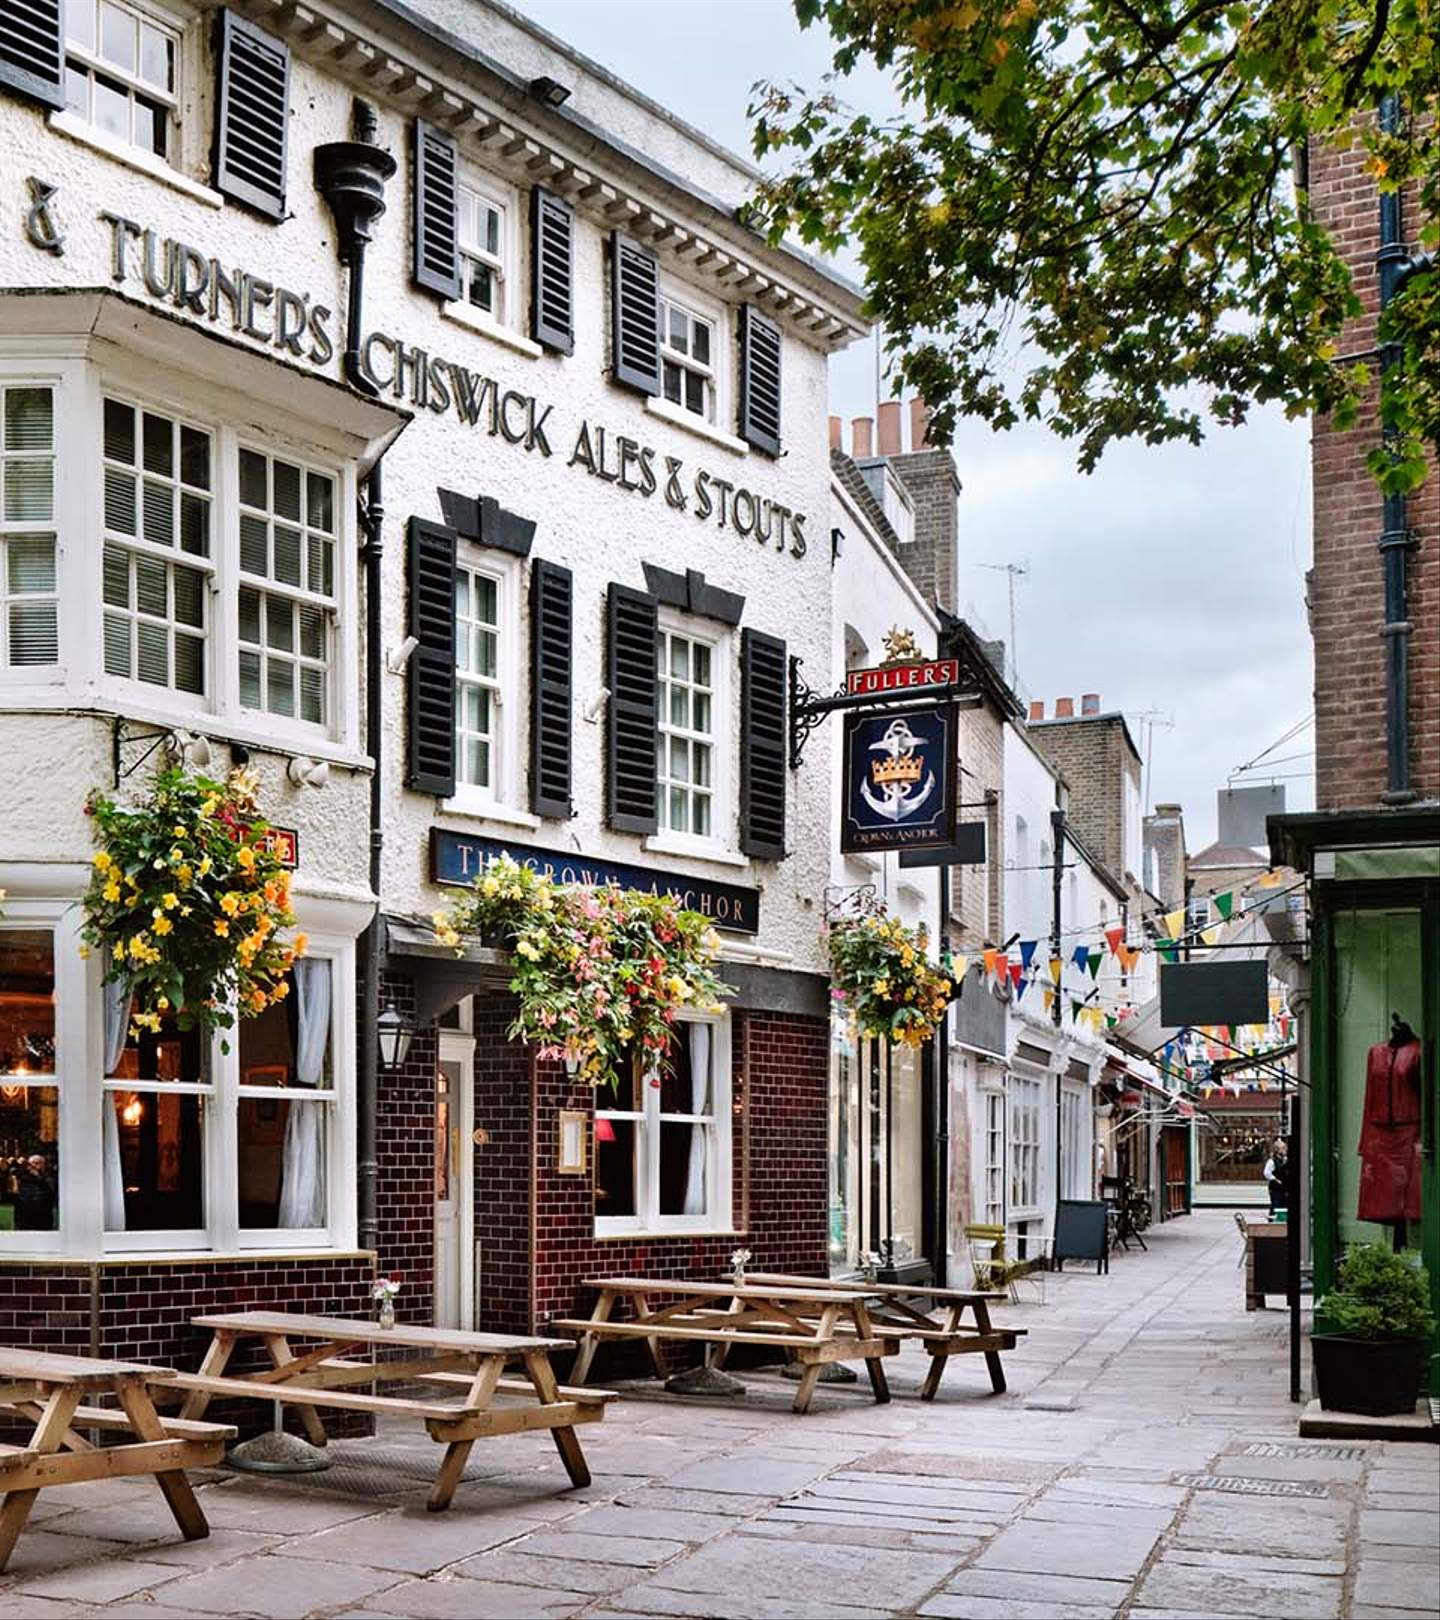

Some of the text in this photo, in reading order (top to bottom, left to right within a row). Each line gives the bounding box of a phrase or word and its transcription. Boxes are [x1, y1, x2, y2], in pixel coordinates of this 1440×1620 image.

[24, 175, 65, 257] &
[98, 209, 333, 365] TURNER'S
[360, 331, 555, 458] CHISWICK
[566, 419, 657, 497] ALES
[664, 455, 689, 513] &
[694, 467, 808, 560] STOUTS
[456, 843, 500, 877] TH
